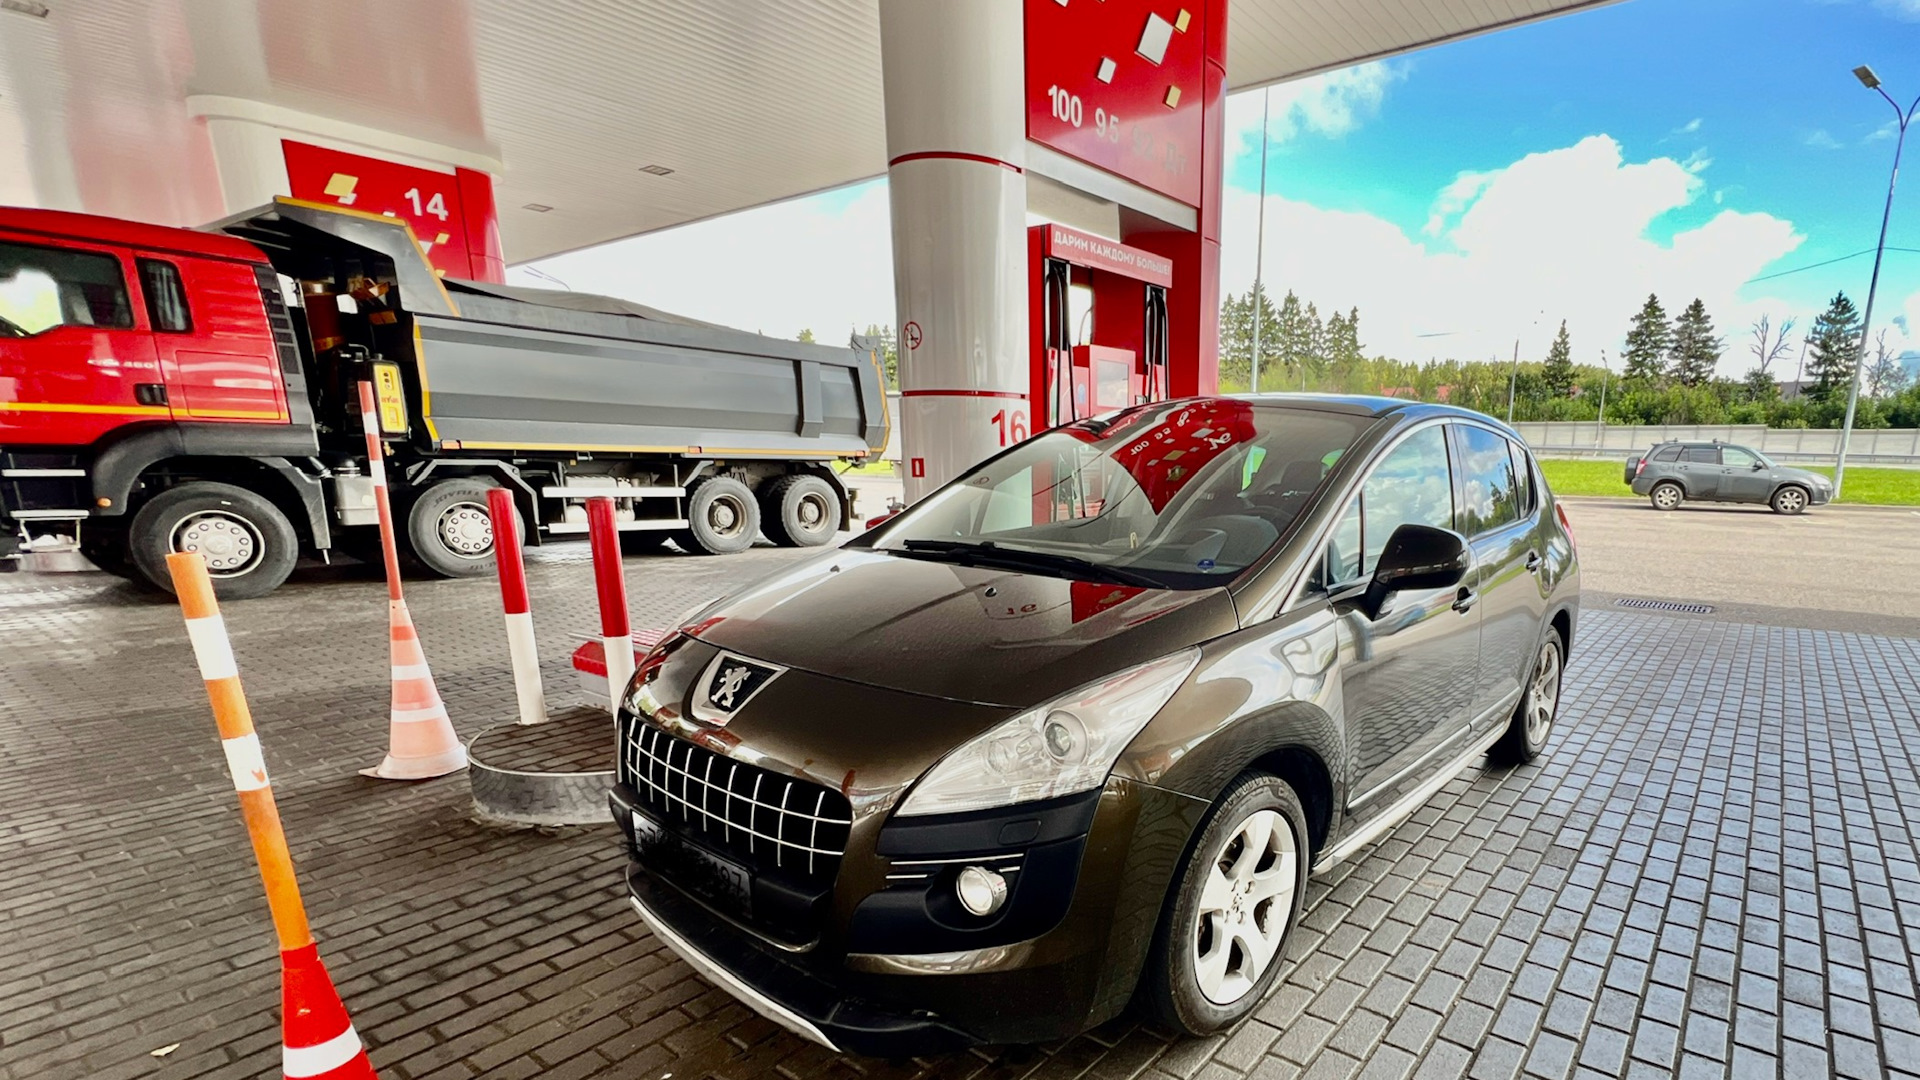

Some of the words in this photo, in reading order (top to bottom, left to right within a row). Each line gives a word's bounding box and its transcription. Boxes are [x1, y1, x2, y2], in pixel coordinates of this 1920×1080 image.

[1048, 84, 1083, 128] 100
[1095, 107, 1119, 143] 95
[404, 188, 449, 221] 14
[1054, 231, 1088, 251] ДАРИМ
[1090, 241, 1135, 264] КАЖДОМУ
[1137, 256, 1171, 275] БОЛЬШЕ!
[991, 409, 1027, 447] 16
